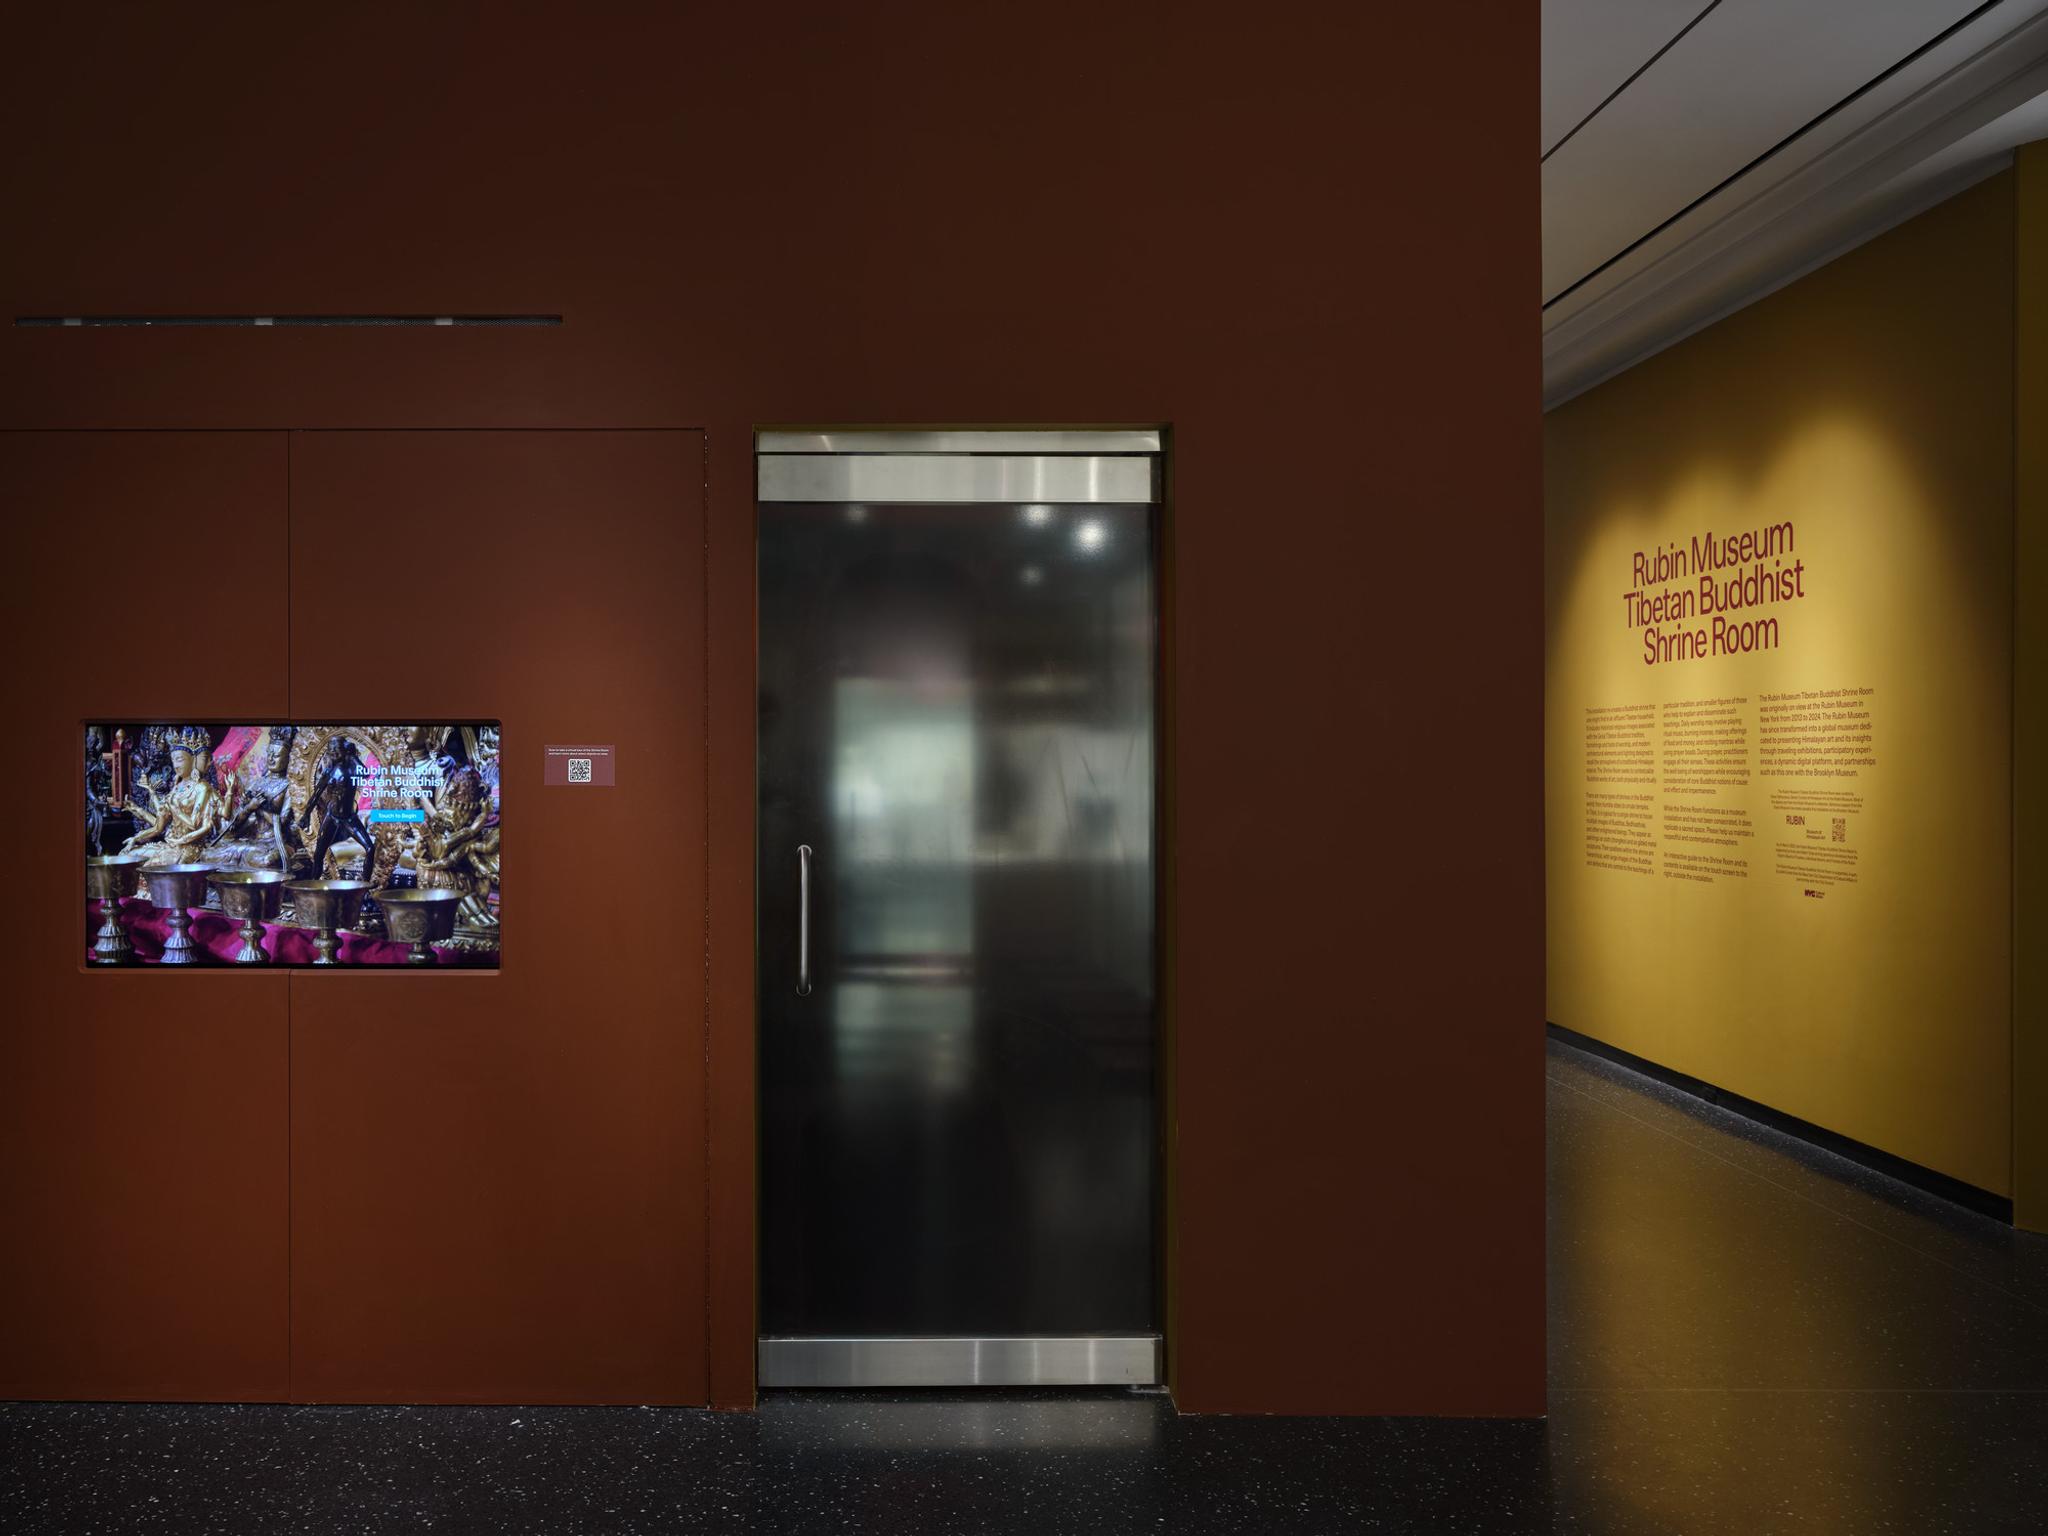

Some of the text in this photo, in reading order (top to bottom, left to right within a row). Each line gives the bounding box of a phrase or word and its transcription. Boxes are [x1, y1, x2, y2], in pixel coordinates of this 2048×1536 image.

[1633, 521, 1794, 588] Rubin Museum
[1624, 559, 1804, 628] Tibetan Buddhist
[1644, 616, 1778, 665] Shrine Room
[356, 765, 439, 775] Rubin Museum
[351, 776, 444, 787] Tibetan Buddhist
[362, 788, 432, 798] Shrine Room
[1786, 815, 1805, 825] RUBIN
